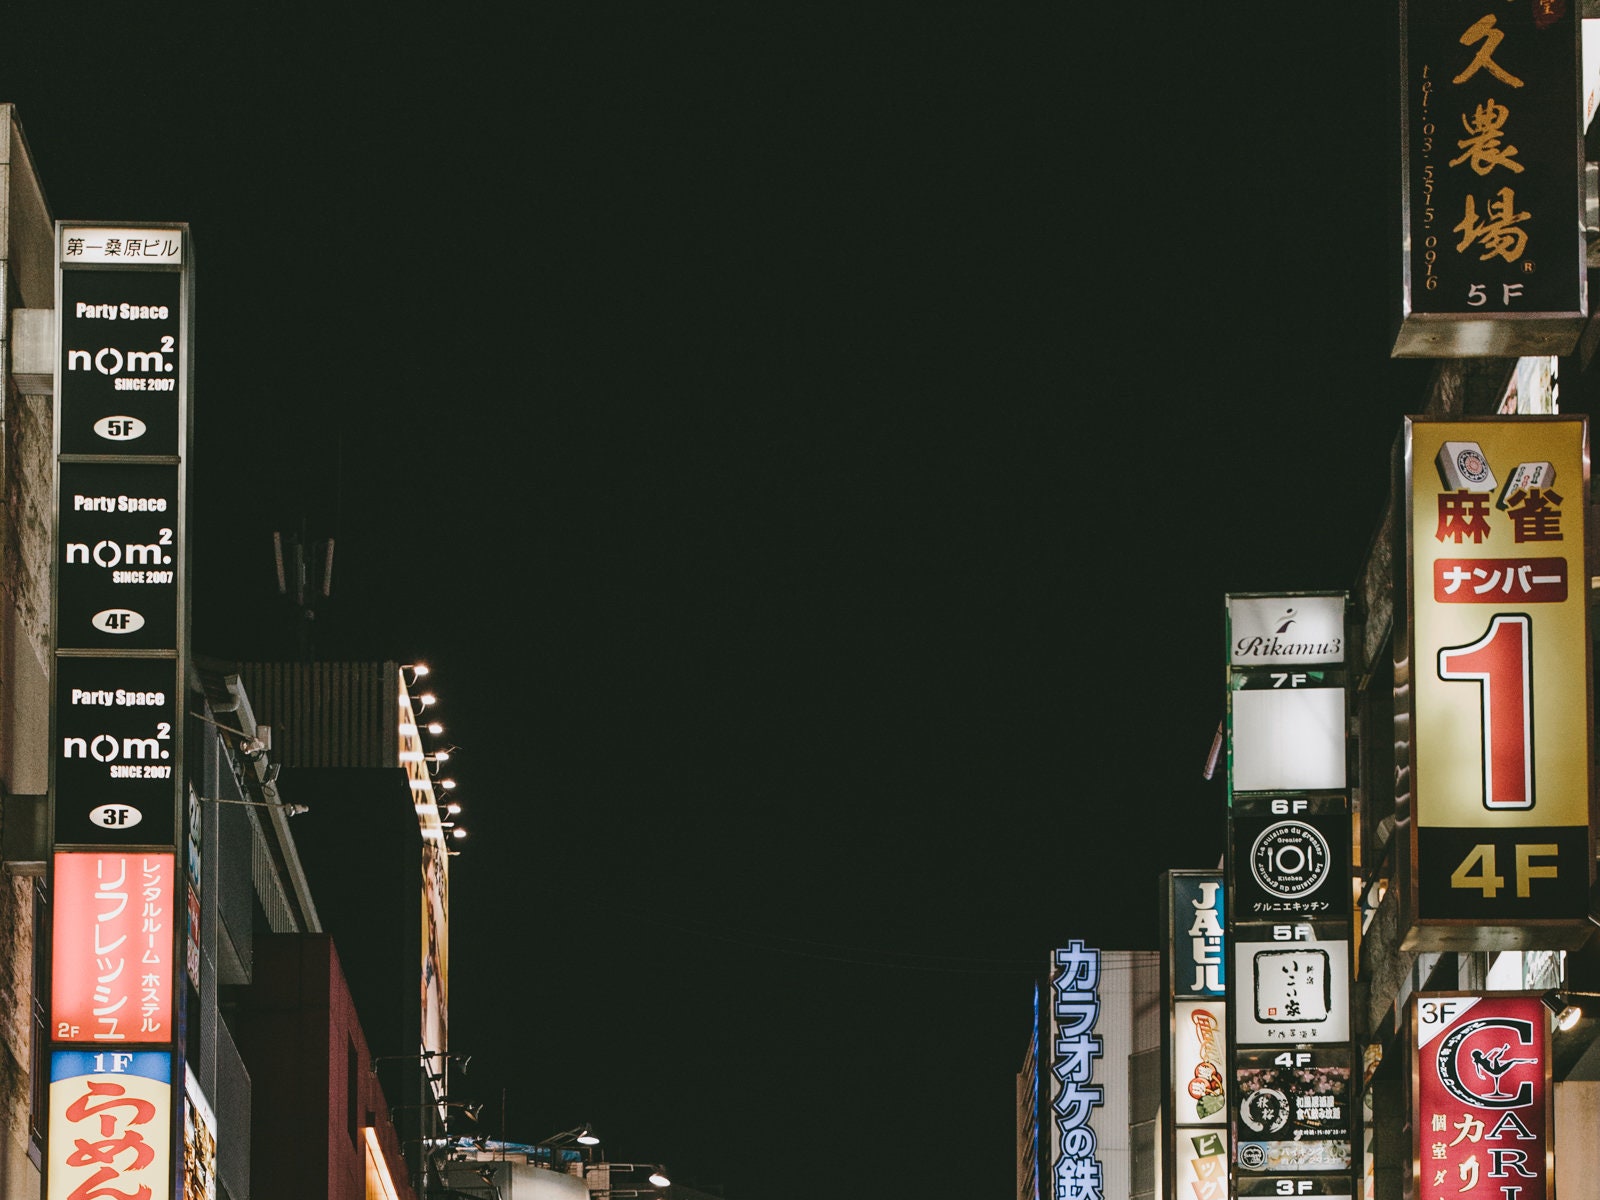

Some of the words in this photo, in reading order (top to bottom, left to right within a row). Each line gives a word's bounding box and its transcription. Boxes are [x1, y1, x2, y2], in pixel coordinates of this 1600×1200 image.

[1449, 13, 1531, 263] 久農場
[66, 238, 179, 258] 第一桑原ビル
[1466, 283, 1524, 306] 5F
[76, 302, 118, 320] Party
[120, 303, 169, 320] Space
[114, 378, 145, 392] SINCE
[146, 378, 175, 392] 2007
[107, 420, 134, 437] 5F
[74, 495, 115, 513] Party
[117, 495, 167, 512] Space
[1435, 488, 1564, 544] 麻雀
[113, 571, 144, 584] SINCE
[145, 571, 173, 584] 2007
[1442, 565, 1561, 595] ナンバー
[104, 613, 131, 630] 4F
[1270, 673, 1307, 688] 7F
[71, 689, 113, 707] Party
[115, 689, 165, 706] Space
[1437, 612, 1536, 812] 1
[110, 765, 141, 778] SINCE
[143, 765, 171, 778] 2007
[1271, 799, 1308, 815] 6F
[103, 808, 129, 825] 3F
[1450, 843, 1559, 899] 4F
[142, 858, 162, 964] レンタルルーム
[1253, 901, 1329, 911] グルニエキッチン
[1188, 882, 1225, 991] JAビル
[1273, 925, 1311, 940] 5F
[93, 858, 128, 1039] リフレッシュ
[141, 973, 161, 1033] ホステル
[1421, 1003, 1457, 1024] 3F
[58, 1022, 80, 1038] 2F
[93, 1053, 133, 1073] 1F
[1274, 1052, 1311, 1067] 4F
[1276, 1180, 1313, 1195] 3F
